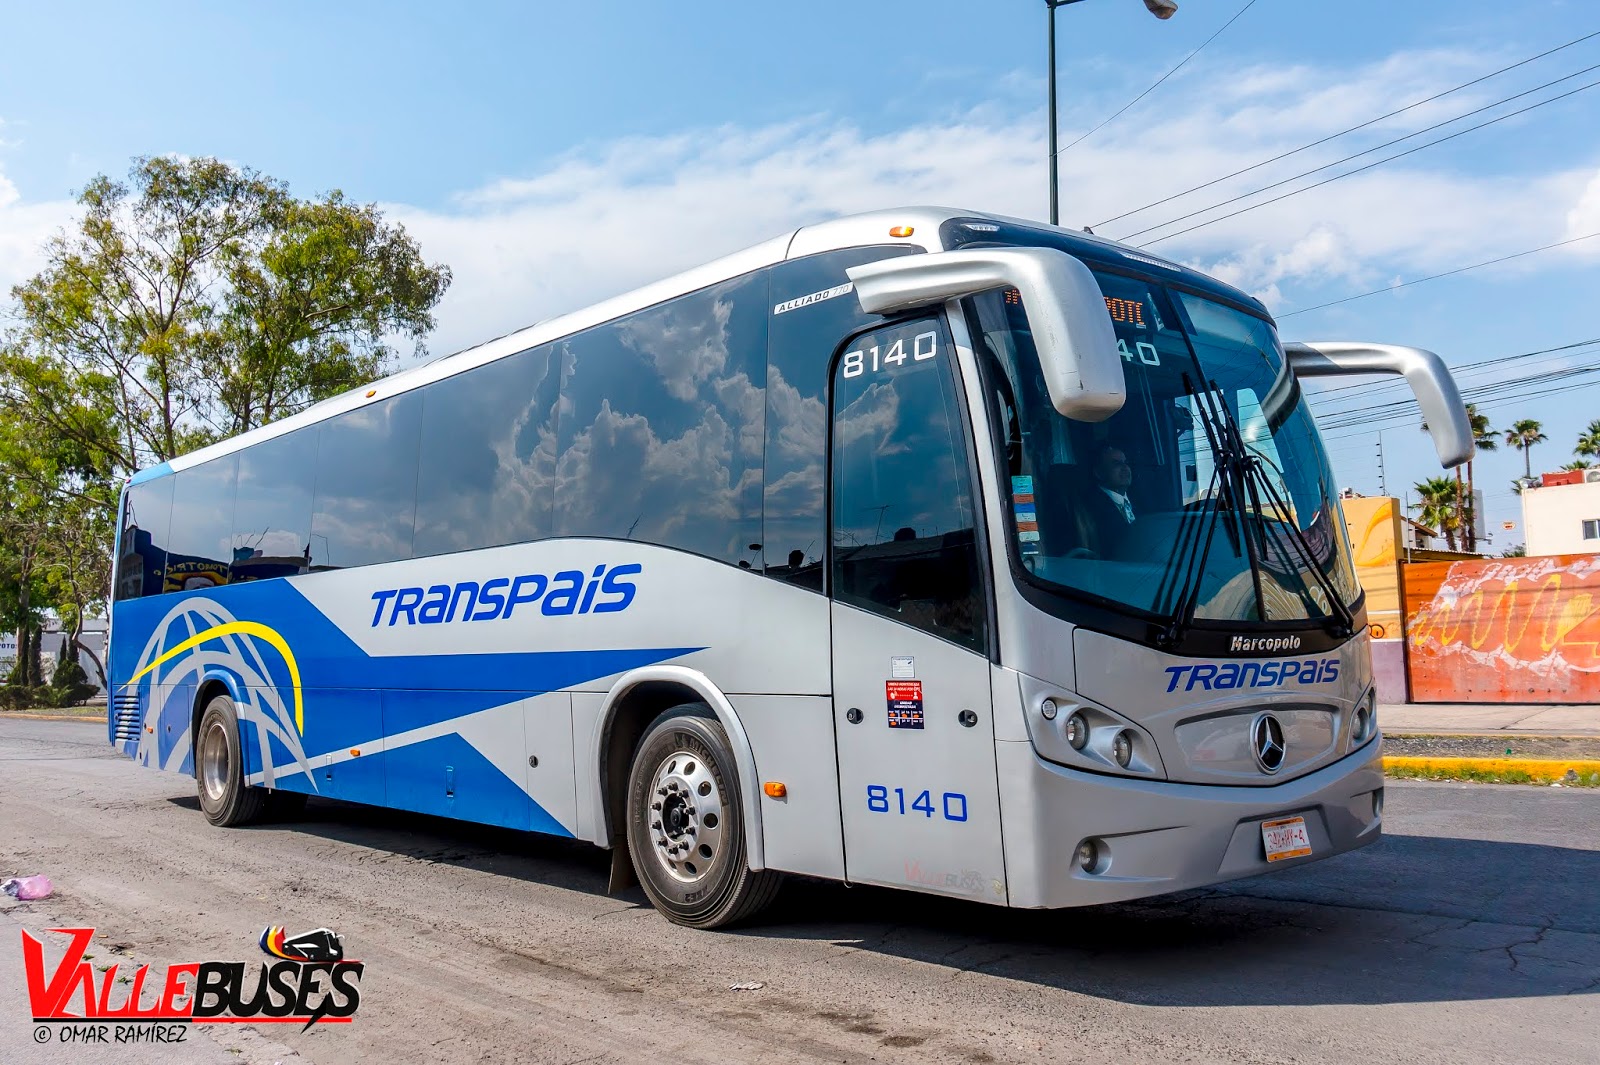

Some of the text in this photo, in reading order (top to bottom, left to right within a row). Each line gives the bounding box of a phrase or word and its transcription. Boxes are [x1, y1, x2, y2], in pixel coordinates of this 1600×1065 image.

[778, 284, 850, 312] ALLIADO 770
[843, 331, 937, 378] 8140
[1230, 635, 1300, 652] Marcopolo
[867, 785, 968, 822] 8140
